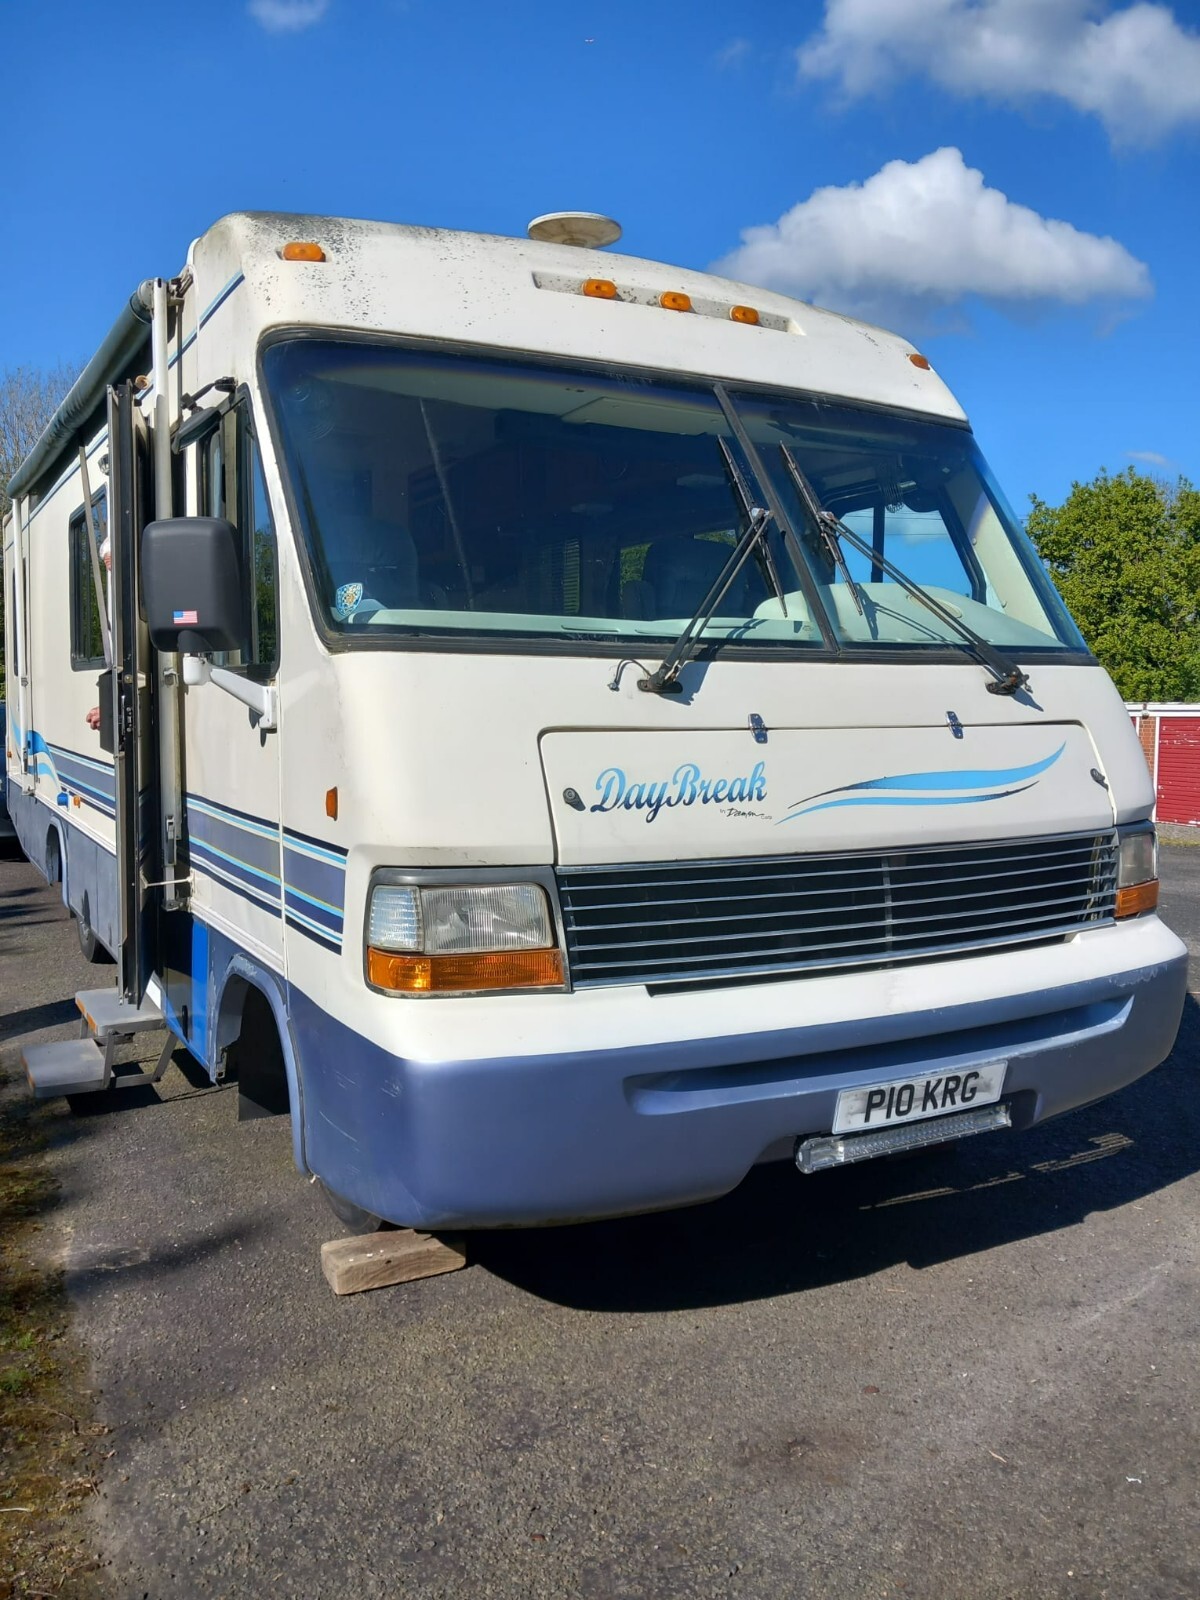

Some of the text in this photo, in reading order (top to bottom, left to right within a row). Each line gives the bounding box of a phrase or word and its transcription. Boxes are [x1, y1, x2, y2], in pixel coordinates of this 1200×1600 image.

[590, 761, 768, 824] DayBreak
[864, 1071, 980, 1123] P10 KRG
